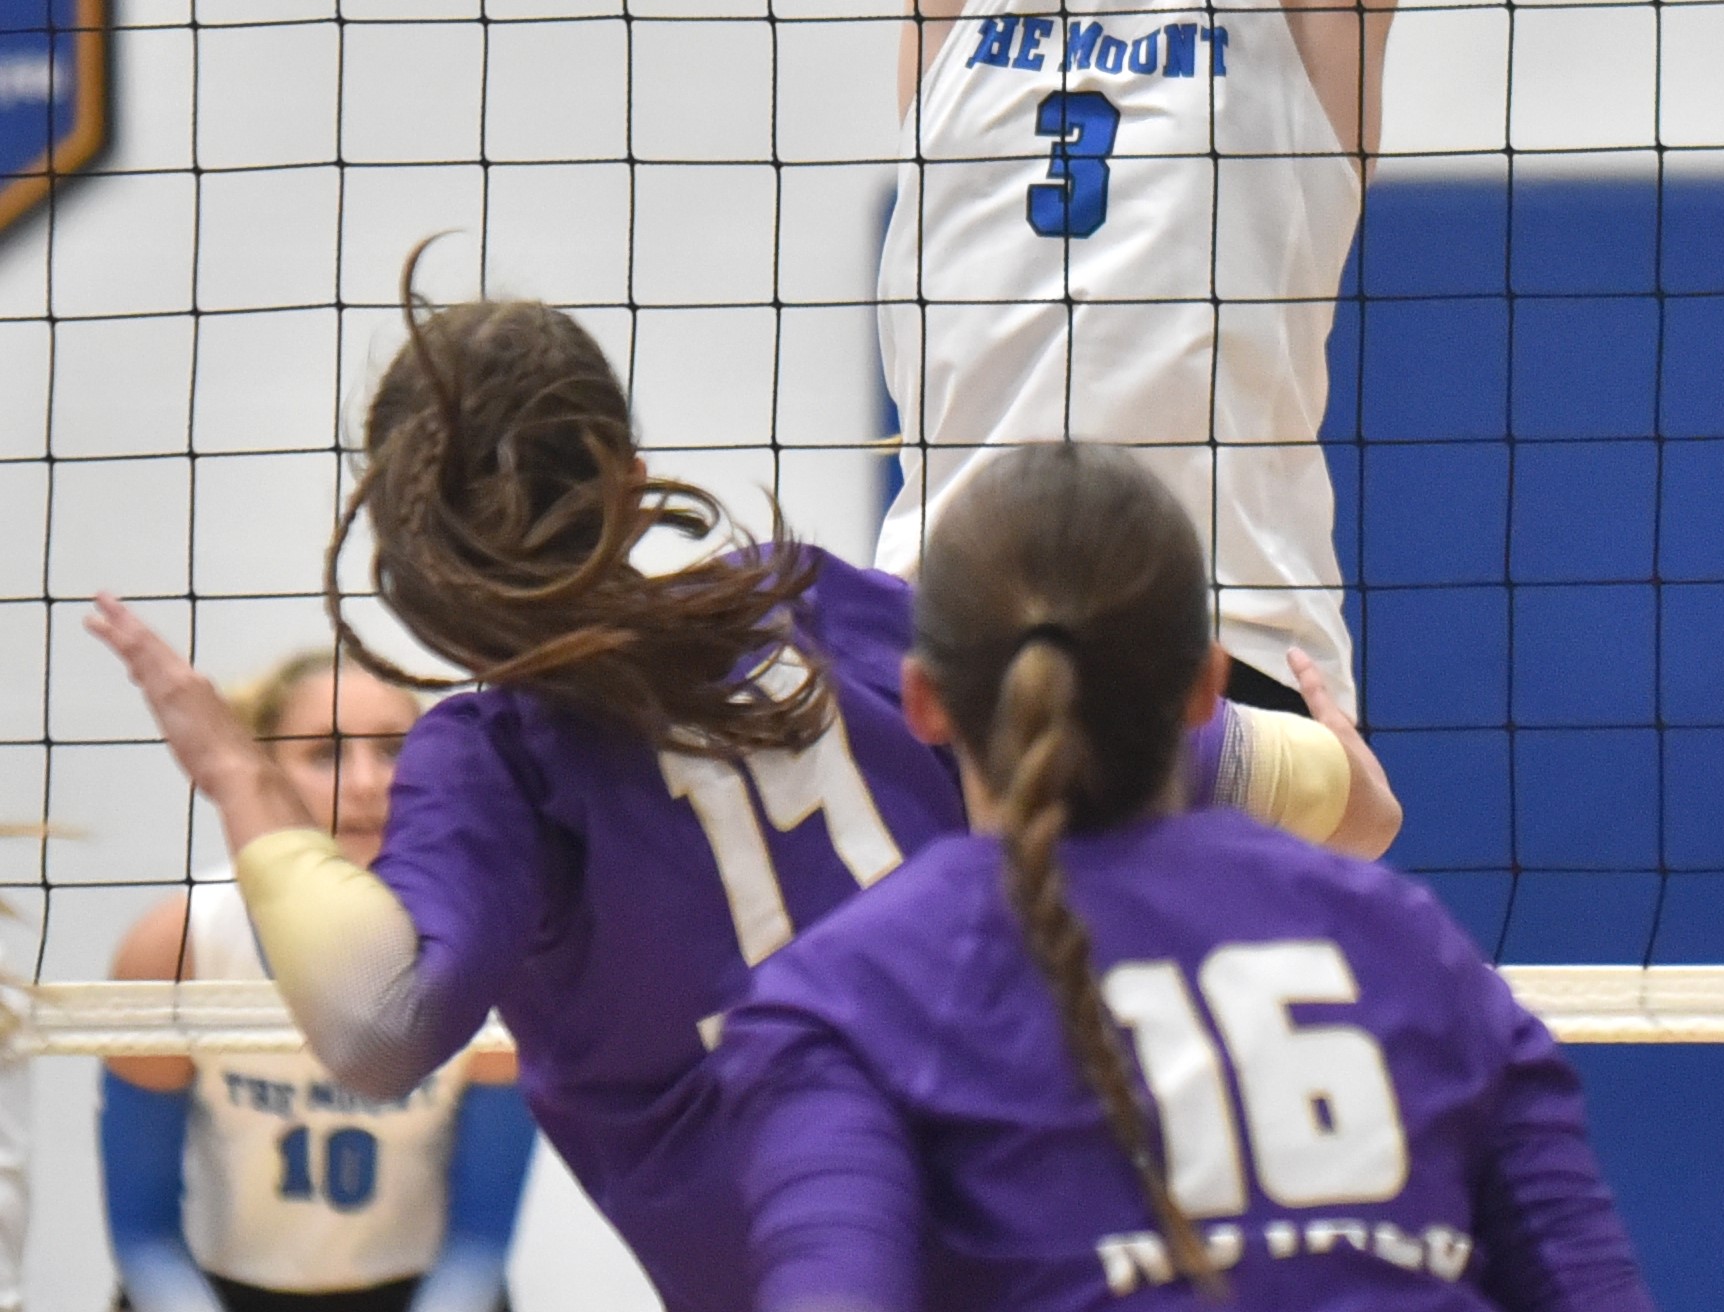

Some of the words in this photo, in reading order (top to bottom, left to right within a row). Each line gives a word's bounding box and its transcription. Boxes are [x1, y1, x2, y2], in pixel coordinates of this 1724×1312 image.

[966, 17, 1053, 72] HE
[1057, 19, 1229, 78] MOUNT
[1026, 89, 1120, 239] 3
[1103, 936, 1408, 1220] 16
[277, 1124, 378, 1213] 10
